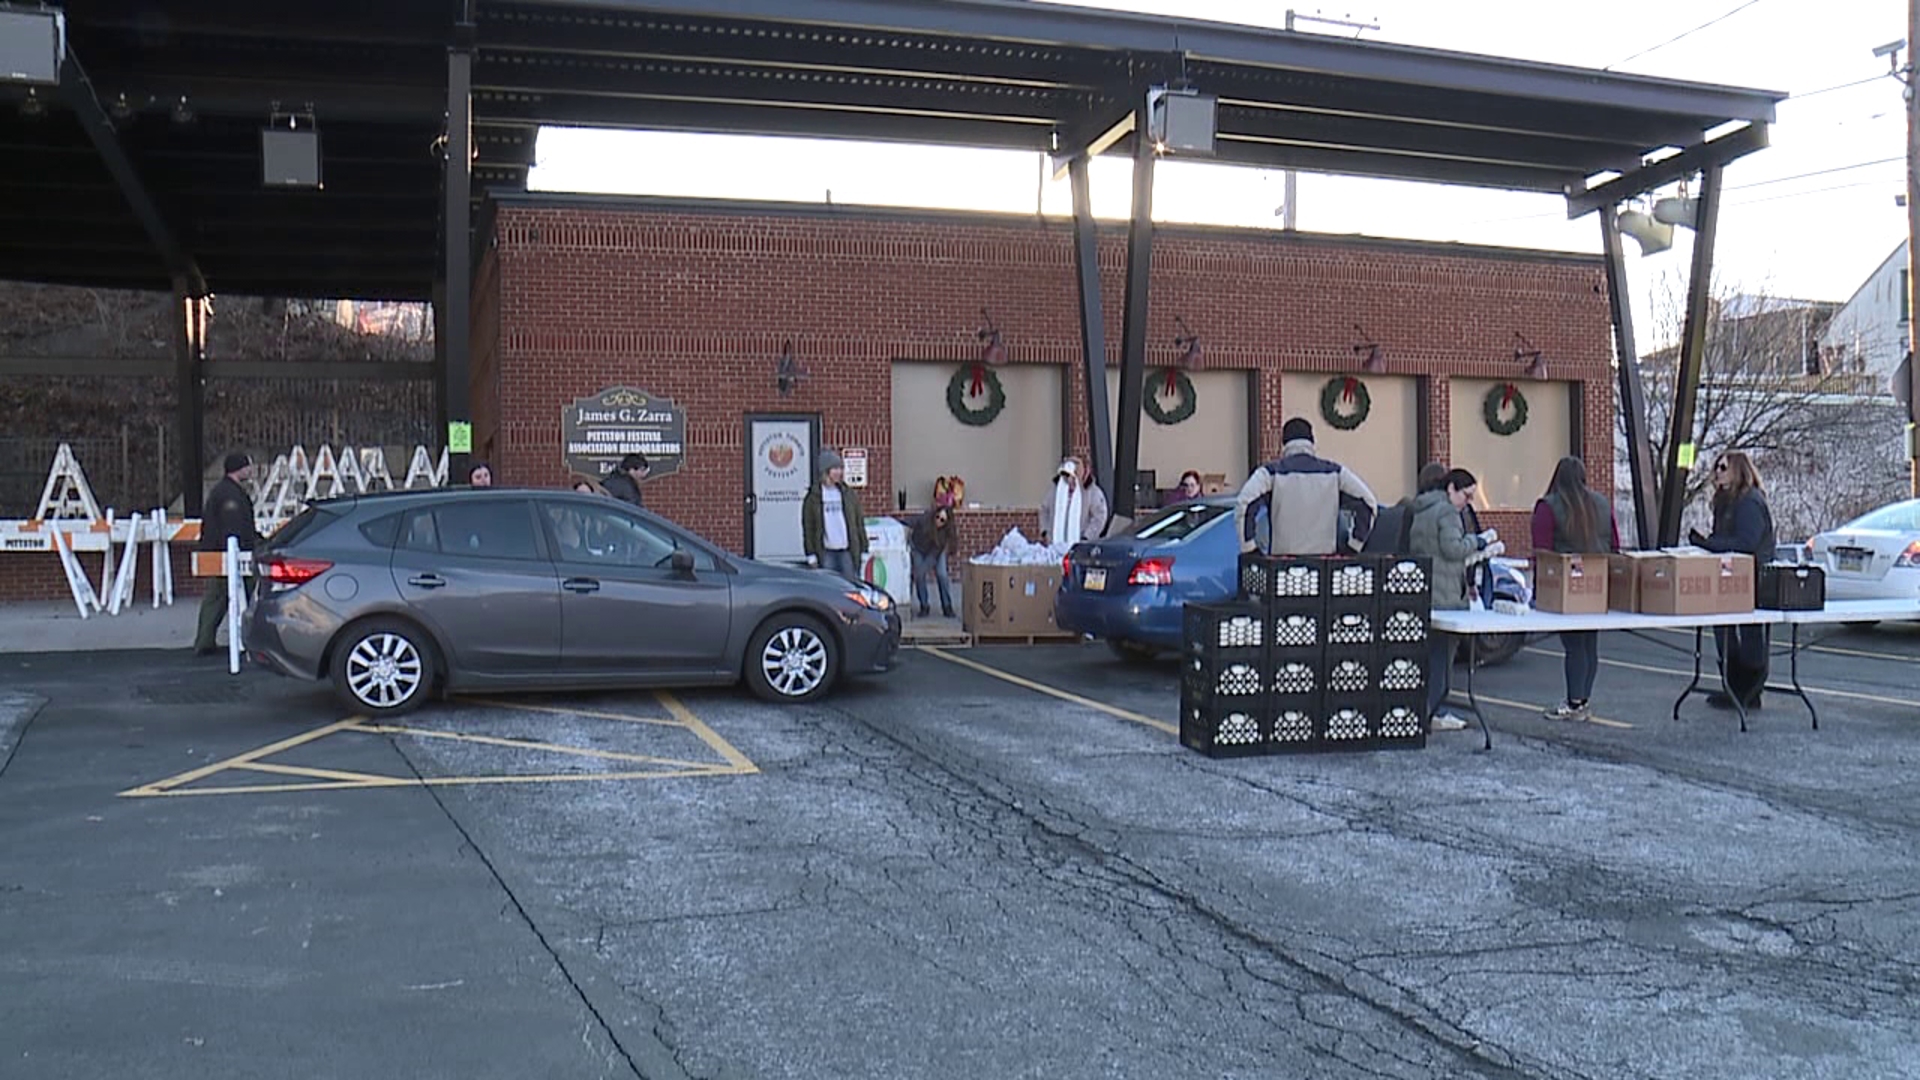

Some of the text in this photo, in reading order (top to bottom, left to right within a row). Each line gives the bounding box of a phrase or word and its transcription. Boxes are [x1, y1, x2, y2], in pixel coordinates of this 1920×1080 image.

[576, 408, 673, 425] James G. Zarra
[586, 431, 662, 442] PITTSTON FESTIVAL
[568, 442, 680, 454] ASSOCIATION HEADQUARTERS
[5, 539, 45, 548] PITTSTON
